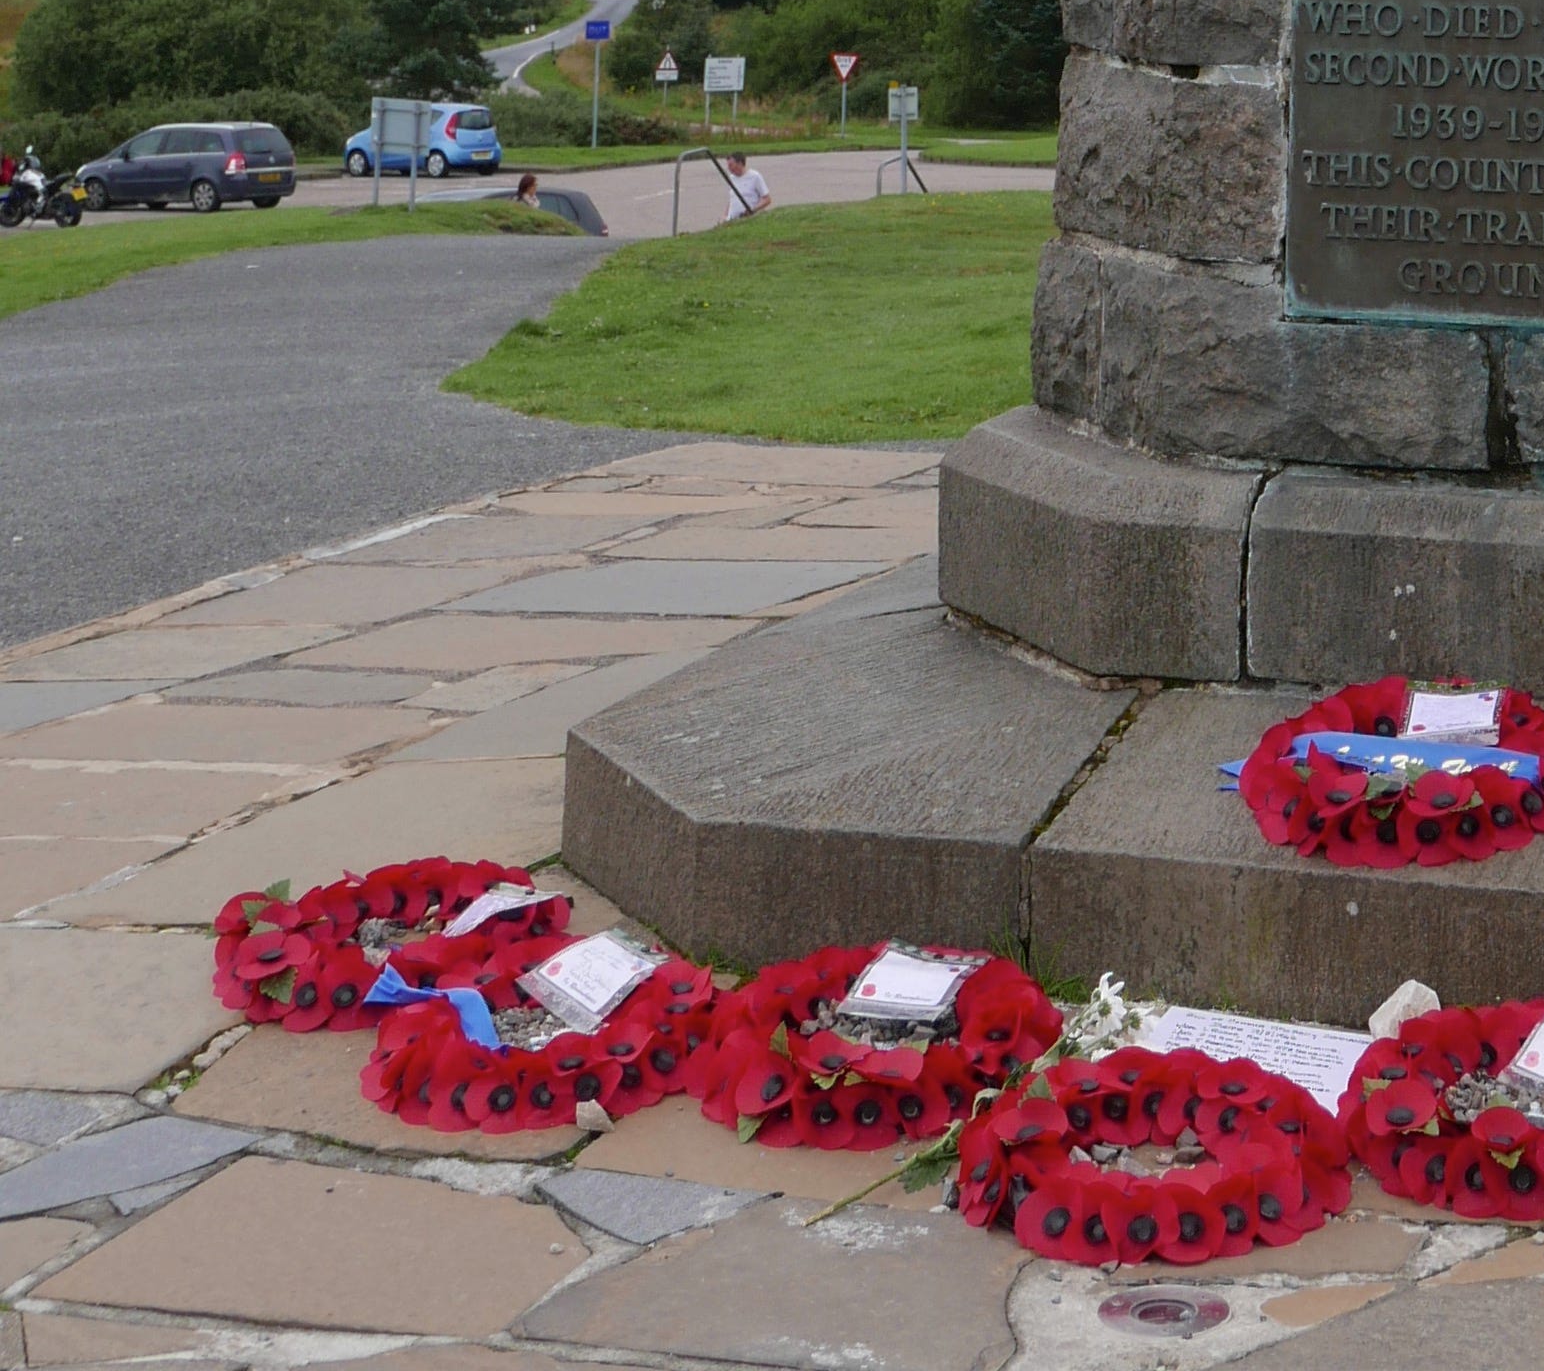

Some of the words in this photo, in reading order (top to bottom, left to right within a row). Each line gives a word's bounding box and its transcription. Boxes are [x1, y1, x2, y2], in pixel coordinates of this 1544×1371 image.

[1302, 0, 1402, 37] WHO
[1421, 2, 1525, 40] DIED
[1304, 51, 1452, 88] SECOND
[1302, 149, 1393, 188] THIS
[1319, 202, 1446, 243] THEIR
